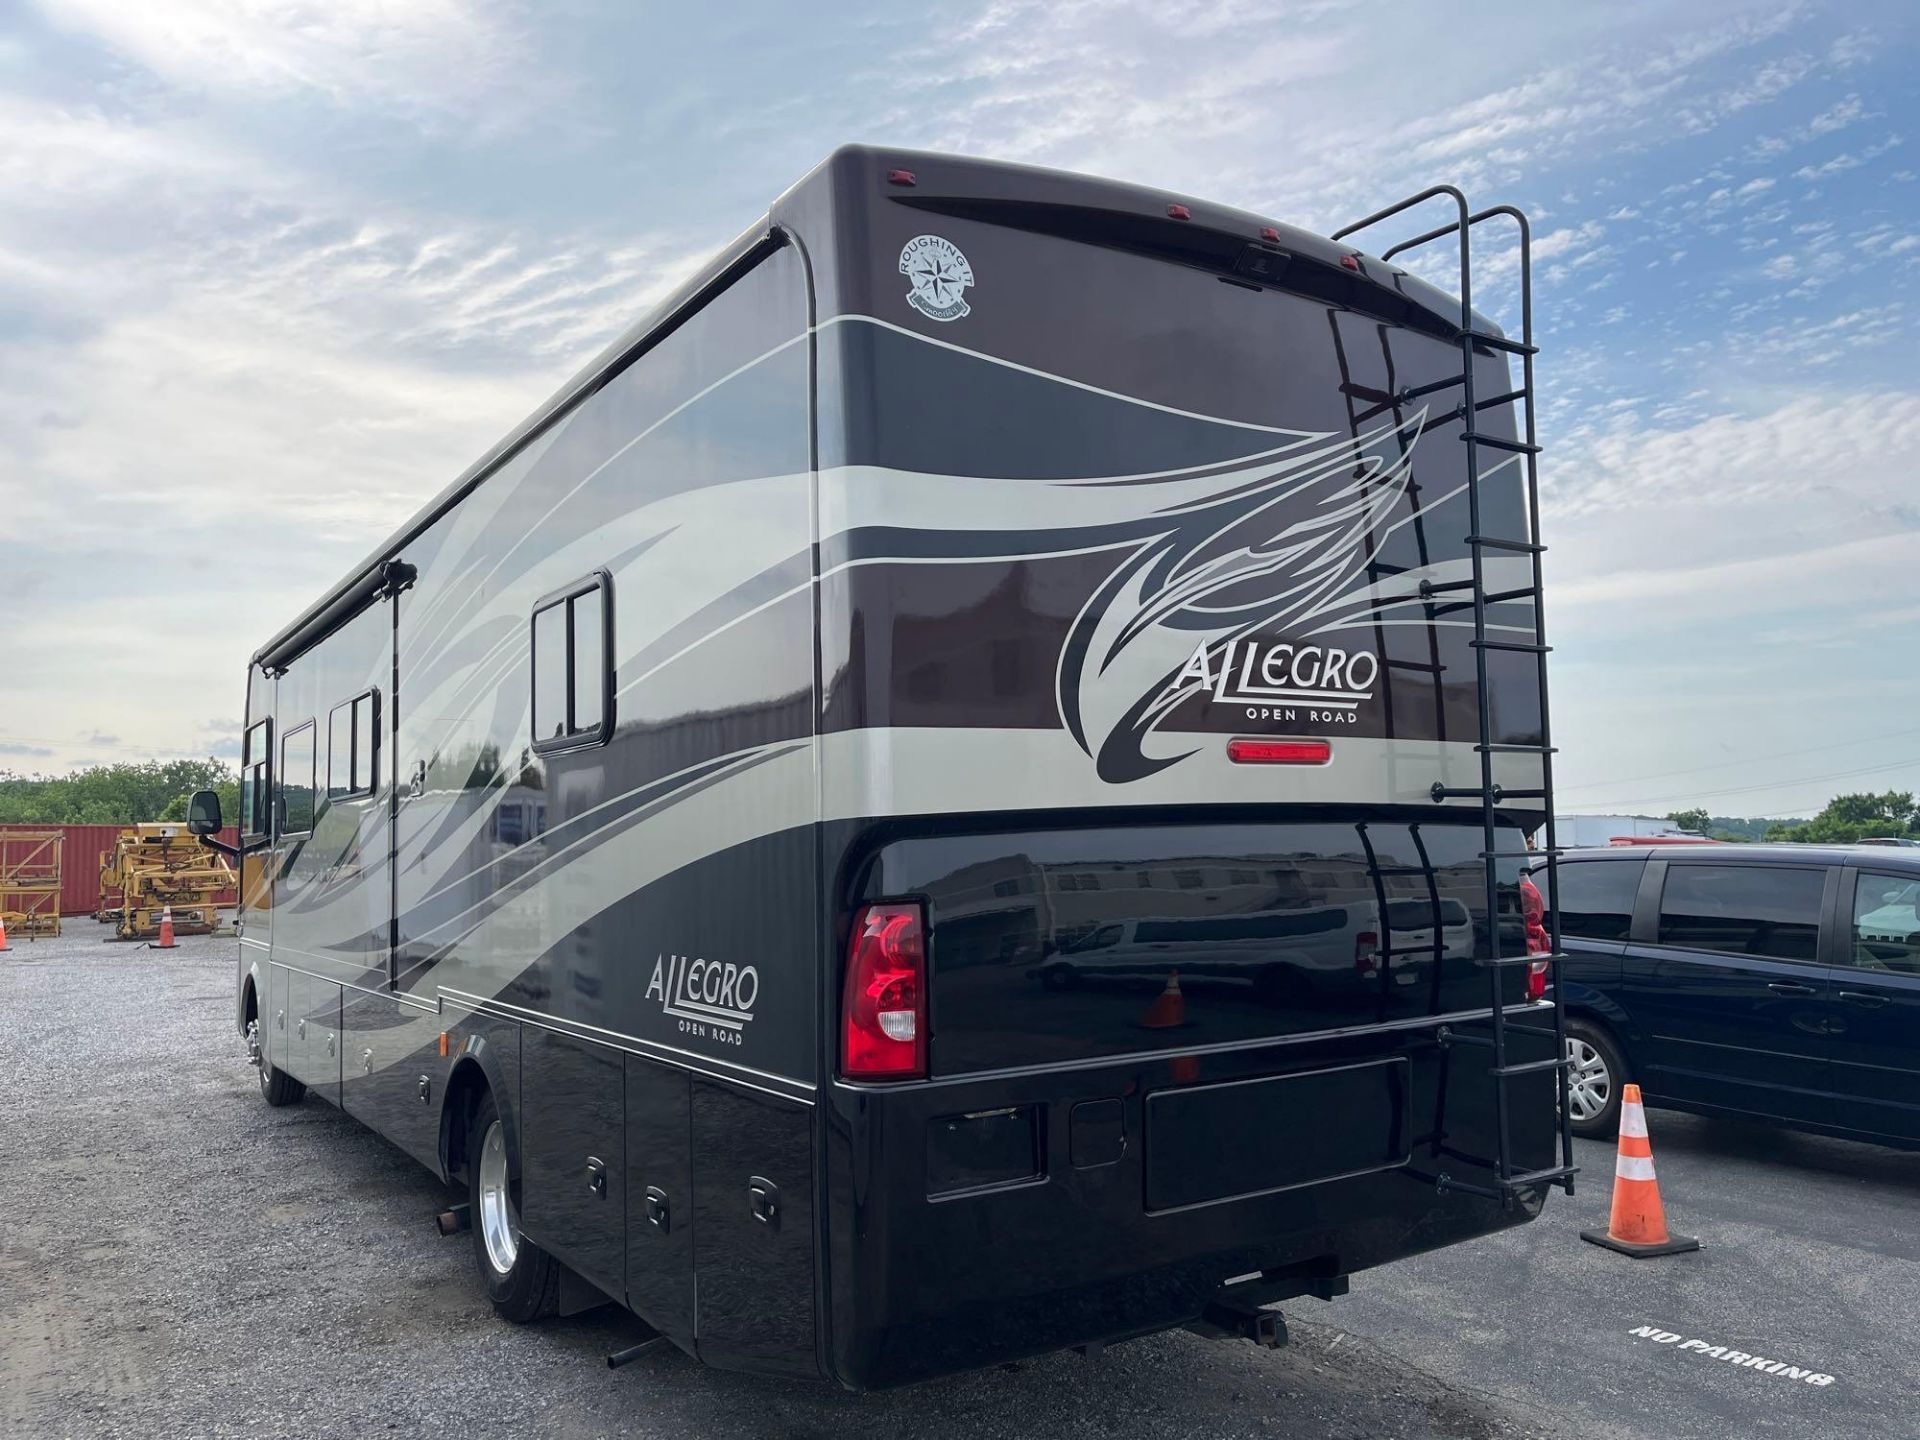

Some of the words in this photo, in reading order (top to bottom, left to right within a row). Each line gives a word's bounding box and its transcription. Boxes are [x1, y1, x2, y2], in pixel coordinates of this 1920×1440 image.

[900, 237, 967, 273] ROUGHING
[1170, 638, 1378, 709] ALLEGRO
[1245, 707, 1296, 721] OPEN
[1310, 710, 1358, 724] ROAD
[645, 952, 759, 1030] ALLEGRO
[678, 1020, 706, 1037] OPEN
[712, 1028, 743, 1046] ROAD
[1628, 1325, 1682, 1344] NO
[1677, 1339, 1836, 1387] PARKING
